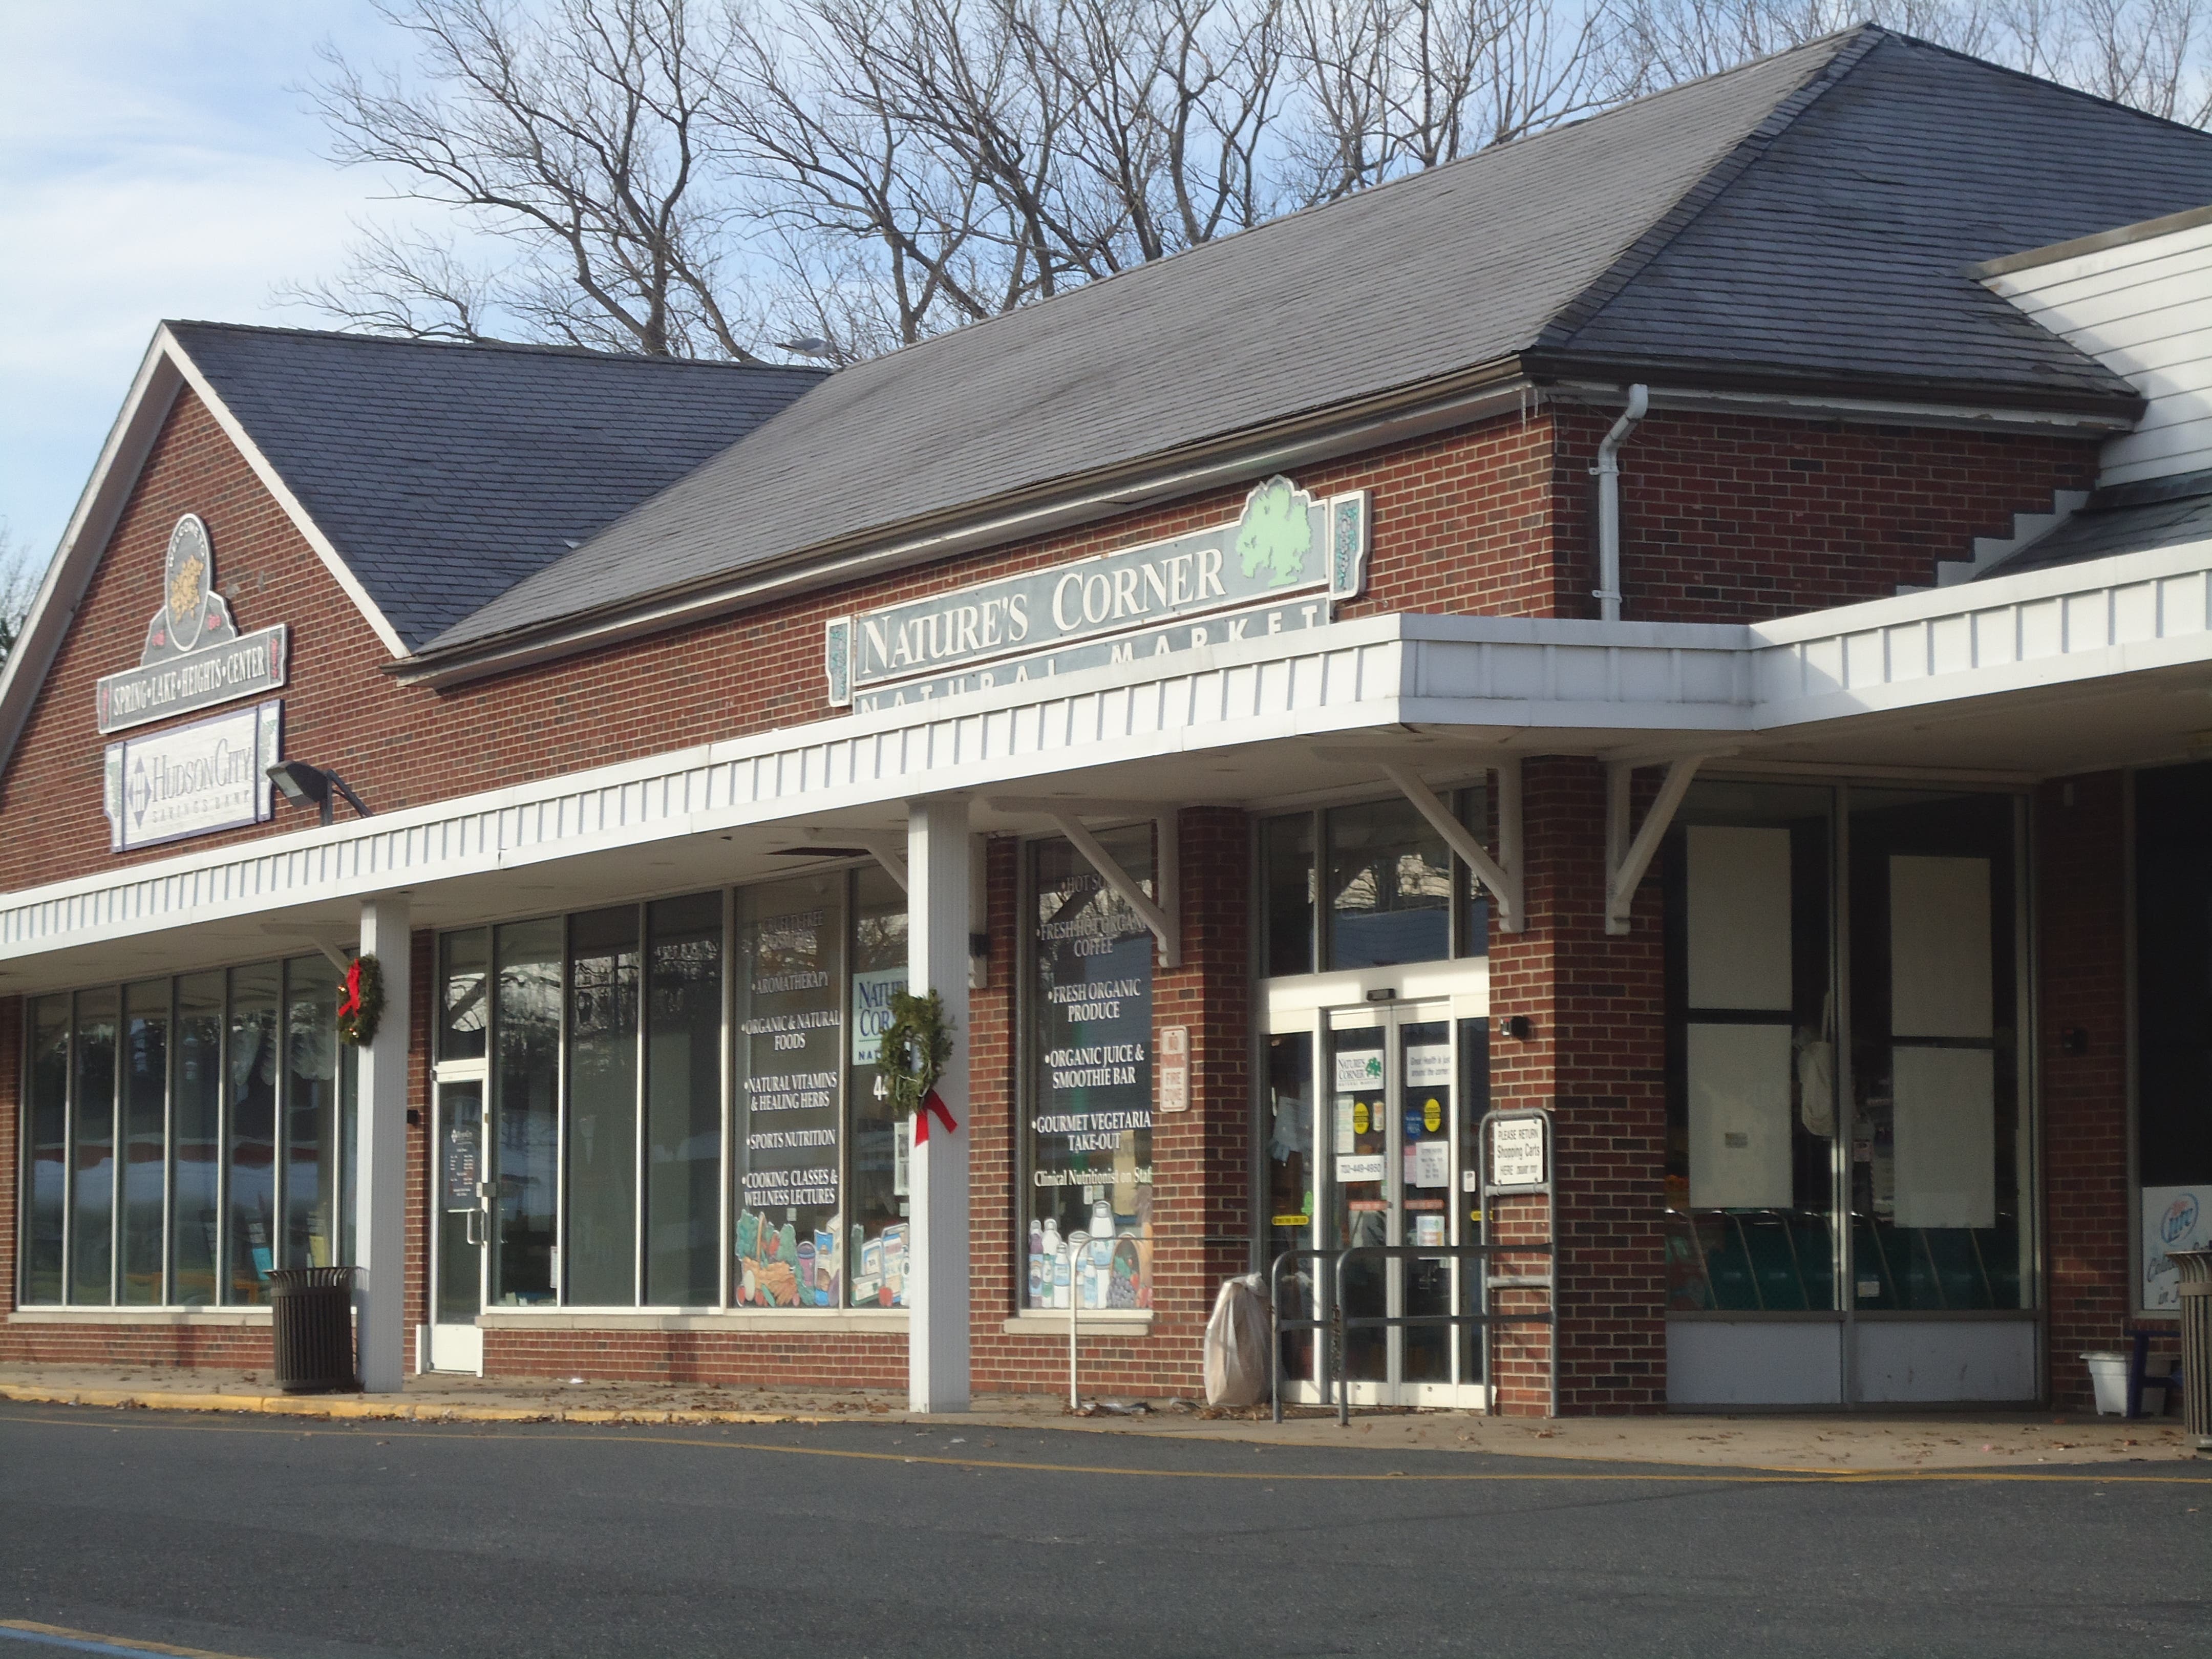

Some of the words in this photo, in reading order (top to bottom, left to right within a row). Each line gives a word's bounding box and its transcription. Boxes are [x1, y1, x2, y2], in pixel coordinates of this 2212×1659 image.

[862, 594, 1029, 674] NATURE'S
[1053, 548, 1226, 631] CORNER
[114, 680, 146, 716] SPRING
[152, 671, 177, 706] LAKE
[181, 658, 222, 697] HEIGHTS
[227, 646, 265, 684] CENTER
[152, 754, 214, 802] HUDSON
[216, 738, 253, 786] CITY
[153, 799, 207, 823] SAVINGS
[215, 790, 249, 810] BANK
[1041, 921, 1074, 941] FRESH
[1075, 917, 1100, 937] HOT
[1074, 937, 1113, 957] COFFEE
[755, 971, 828, 994] AROMATHERAPY
[1053, 984, 1087, 1004] FRESH
[1088, 979, 1141, 999] ORGANIC
[746, 1015, 788, 1035] ORGANIC
[788, 1015, 796, 1030] &
[797, 1010, 840, 1029] NATURAL
[1068, 1001, 1120, 1022] PRODUCE
[774, 1033, 806, 1050] FOODS
[1050, 1047, 1101, 1068] ORGANIC
[1102, 1045, 1133, 1068] JUICE
[1135, 1044, 1145, 1061] &
[749, 1076, 791, 1093] NATURAL
[792, 1071, 837, 1090] VITAMINS
[1052, 1069, 1111, 1089] SMOOTHIE
[1113, 1067, 1137, 1084] BAR
[751, 1096, 758, 1112] &
[759, 1093, 799, 1111] HEALING
[800, 1091, 830, 1108] HERBS
[1037, 1115, 1090, 1133] GOURMET
[1090, 1111, 1153, 1130] VEGETARIA
[750, 1132, 784, 1150] SPORTS
[784, 1130, 836, 1147] NUTRITION
[1068, 1133, 1121, 1151] TAKE-OUT
[1498, 1130, 1517, 1141] PLEASE
[1518, 1128, 1538, 1139] RETURN
[1497, 1144, 1522, 1160] Shopping
[1525, 1143, 1540, 1157] Carts
[746, 1171, 789, 1188] COOKING
[790, 1169, 829, 1186] CLASSES
[830, 1169, 839, 1185] &
[1034, 1169, 1068, 1187] Clinical
[1069, 1167, 1118, 1185] Nutritionist
[1119, 1171, 1132, 1183] on
[1135, 1166, 1153, 1183] Staf
[745, 1189, 790, 1206] WELLNESS
[790, 1188, 836, 1205] LECTURES
